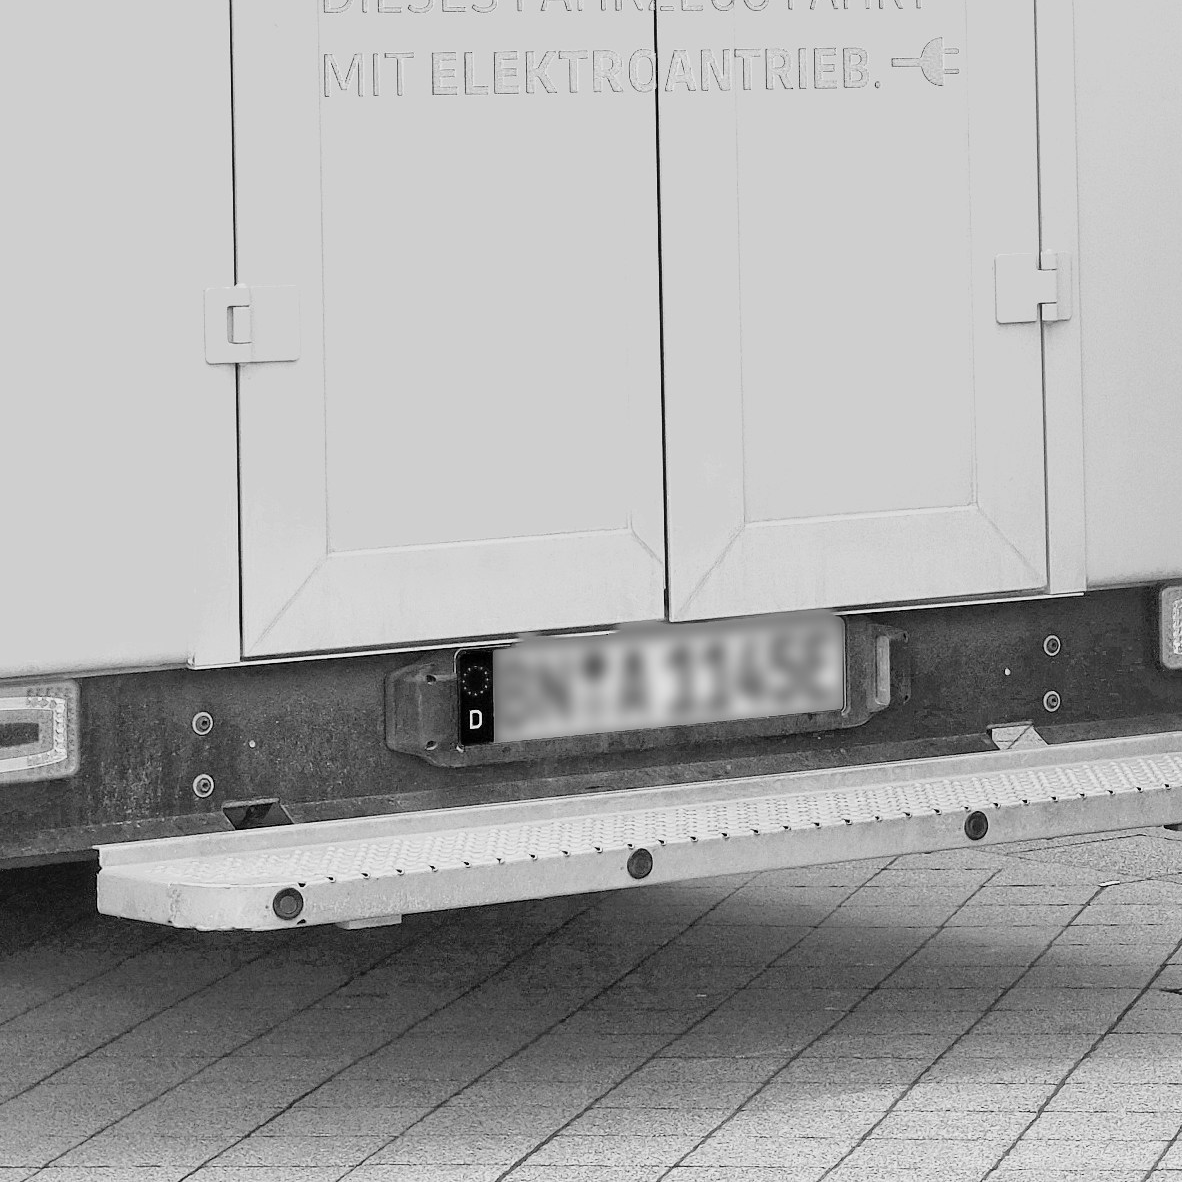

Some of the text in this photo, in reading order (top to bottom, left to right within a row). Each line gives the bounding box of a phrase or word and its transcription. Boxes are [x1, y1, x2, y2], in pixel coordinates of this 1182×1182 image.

[323, 47, 881, 97] MIT ELEKTROANTRIEB.
[469, 709, 483, 730] D
